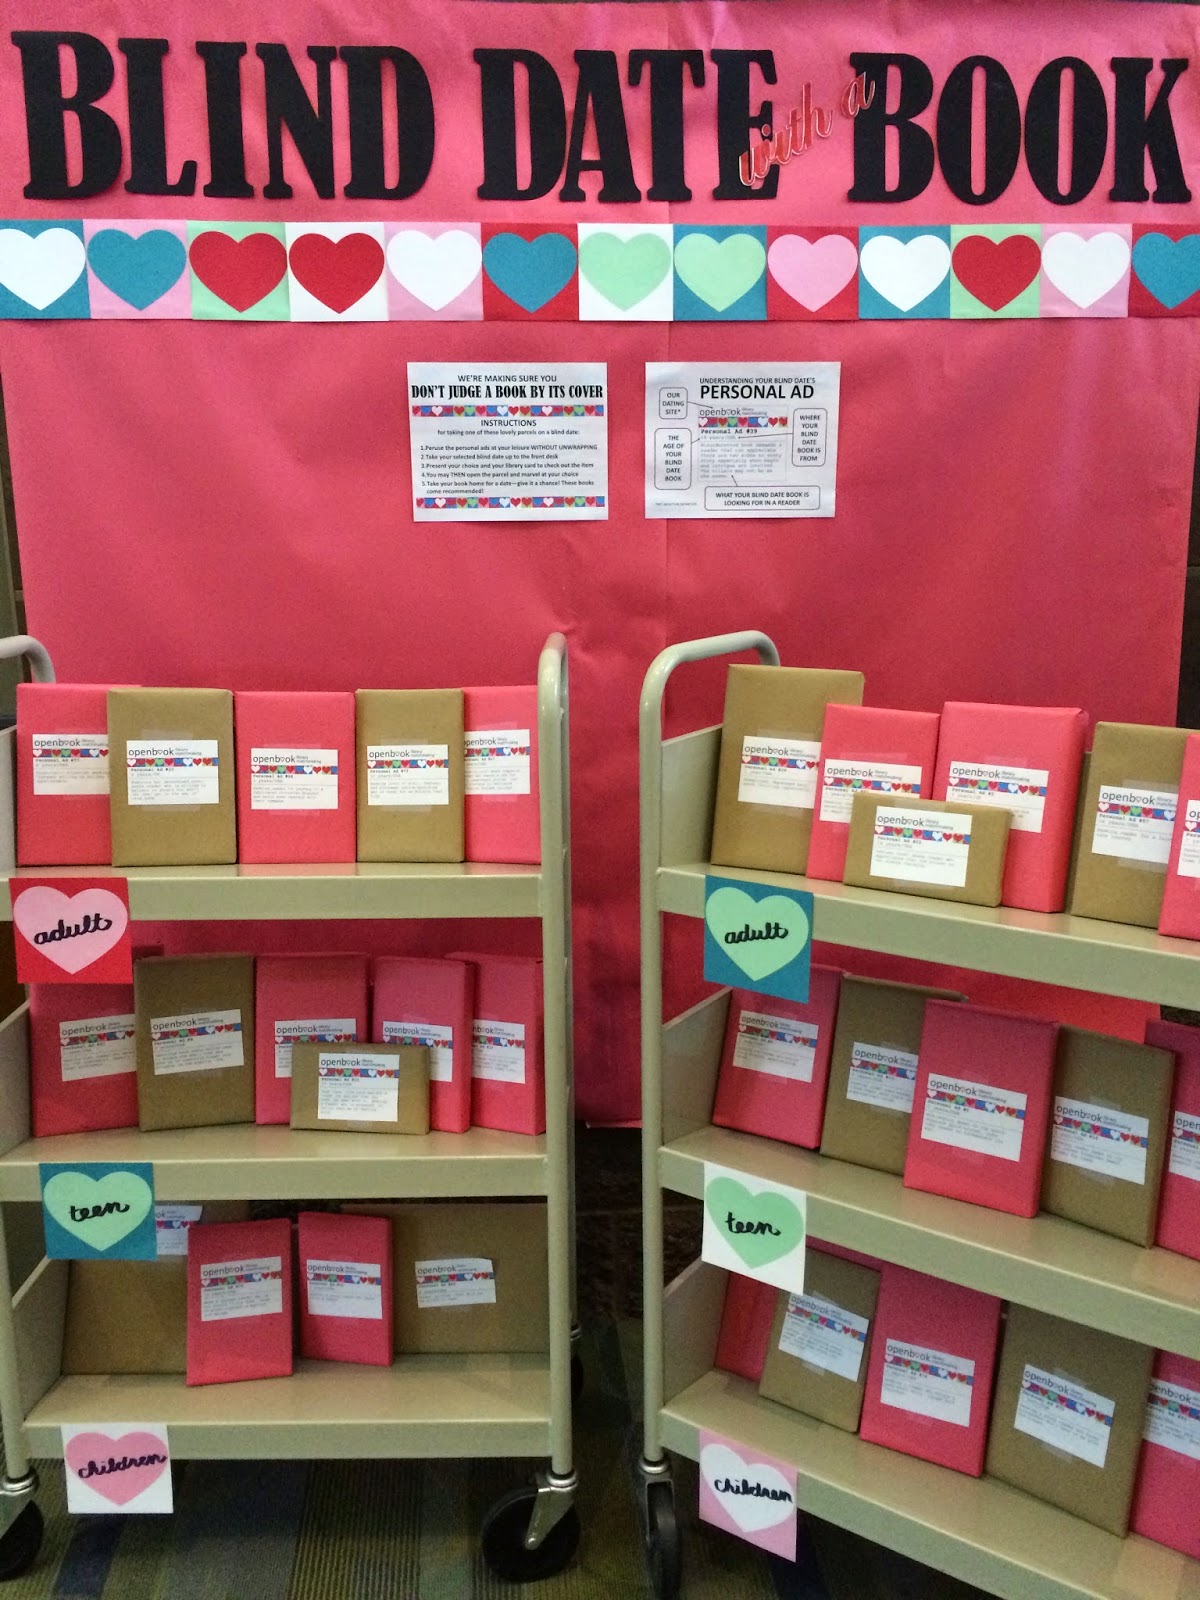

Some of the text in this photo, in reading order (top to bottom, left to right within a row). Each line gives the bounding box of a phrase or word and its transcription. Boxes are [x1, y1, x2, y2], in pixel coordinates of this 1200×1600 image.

[11, 31, 1192, 205] BLIND DATE with a BOOK
[411, 385, 603, 400] DON'T JUDGE A BOOK BY ITS COVER
[701, 385, 814, 399] PERSONAL AD
[34, 913, 112, 945] adult
[724, 922, 788, 944] adult
[68, 1202, 130, 1222] teen
[725, 1211, 781, 1236] teen
[78, 1454, 167, 1478] children
[714, 1478, 793, 1503] children
